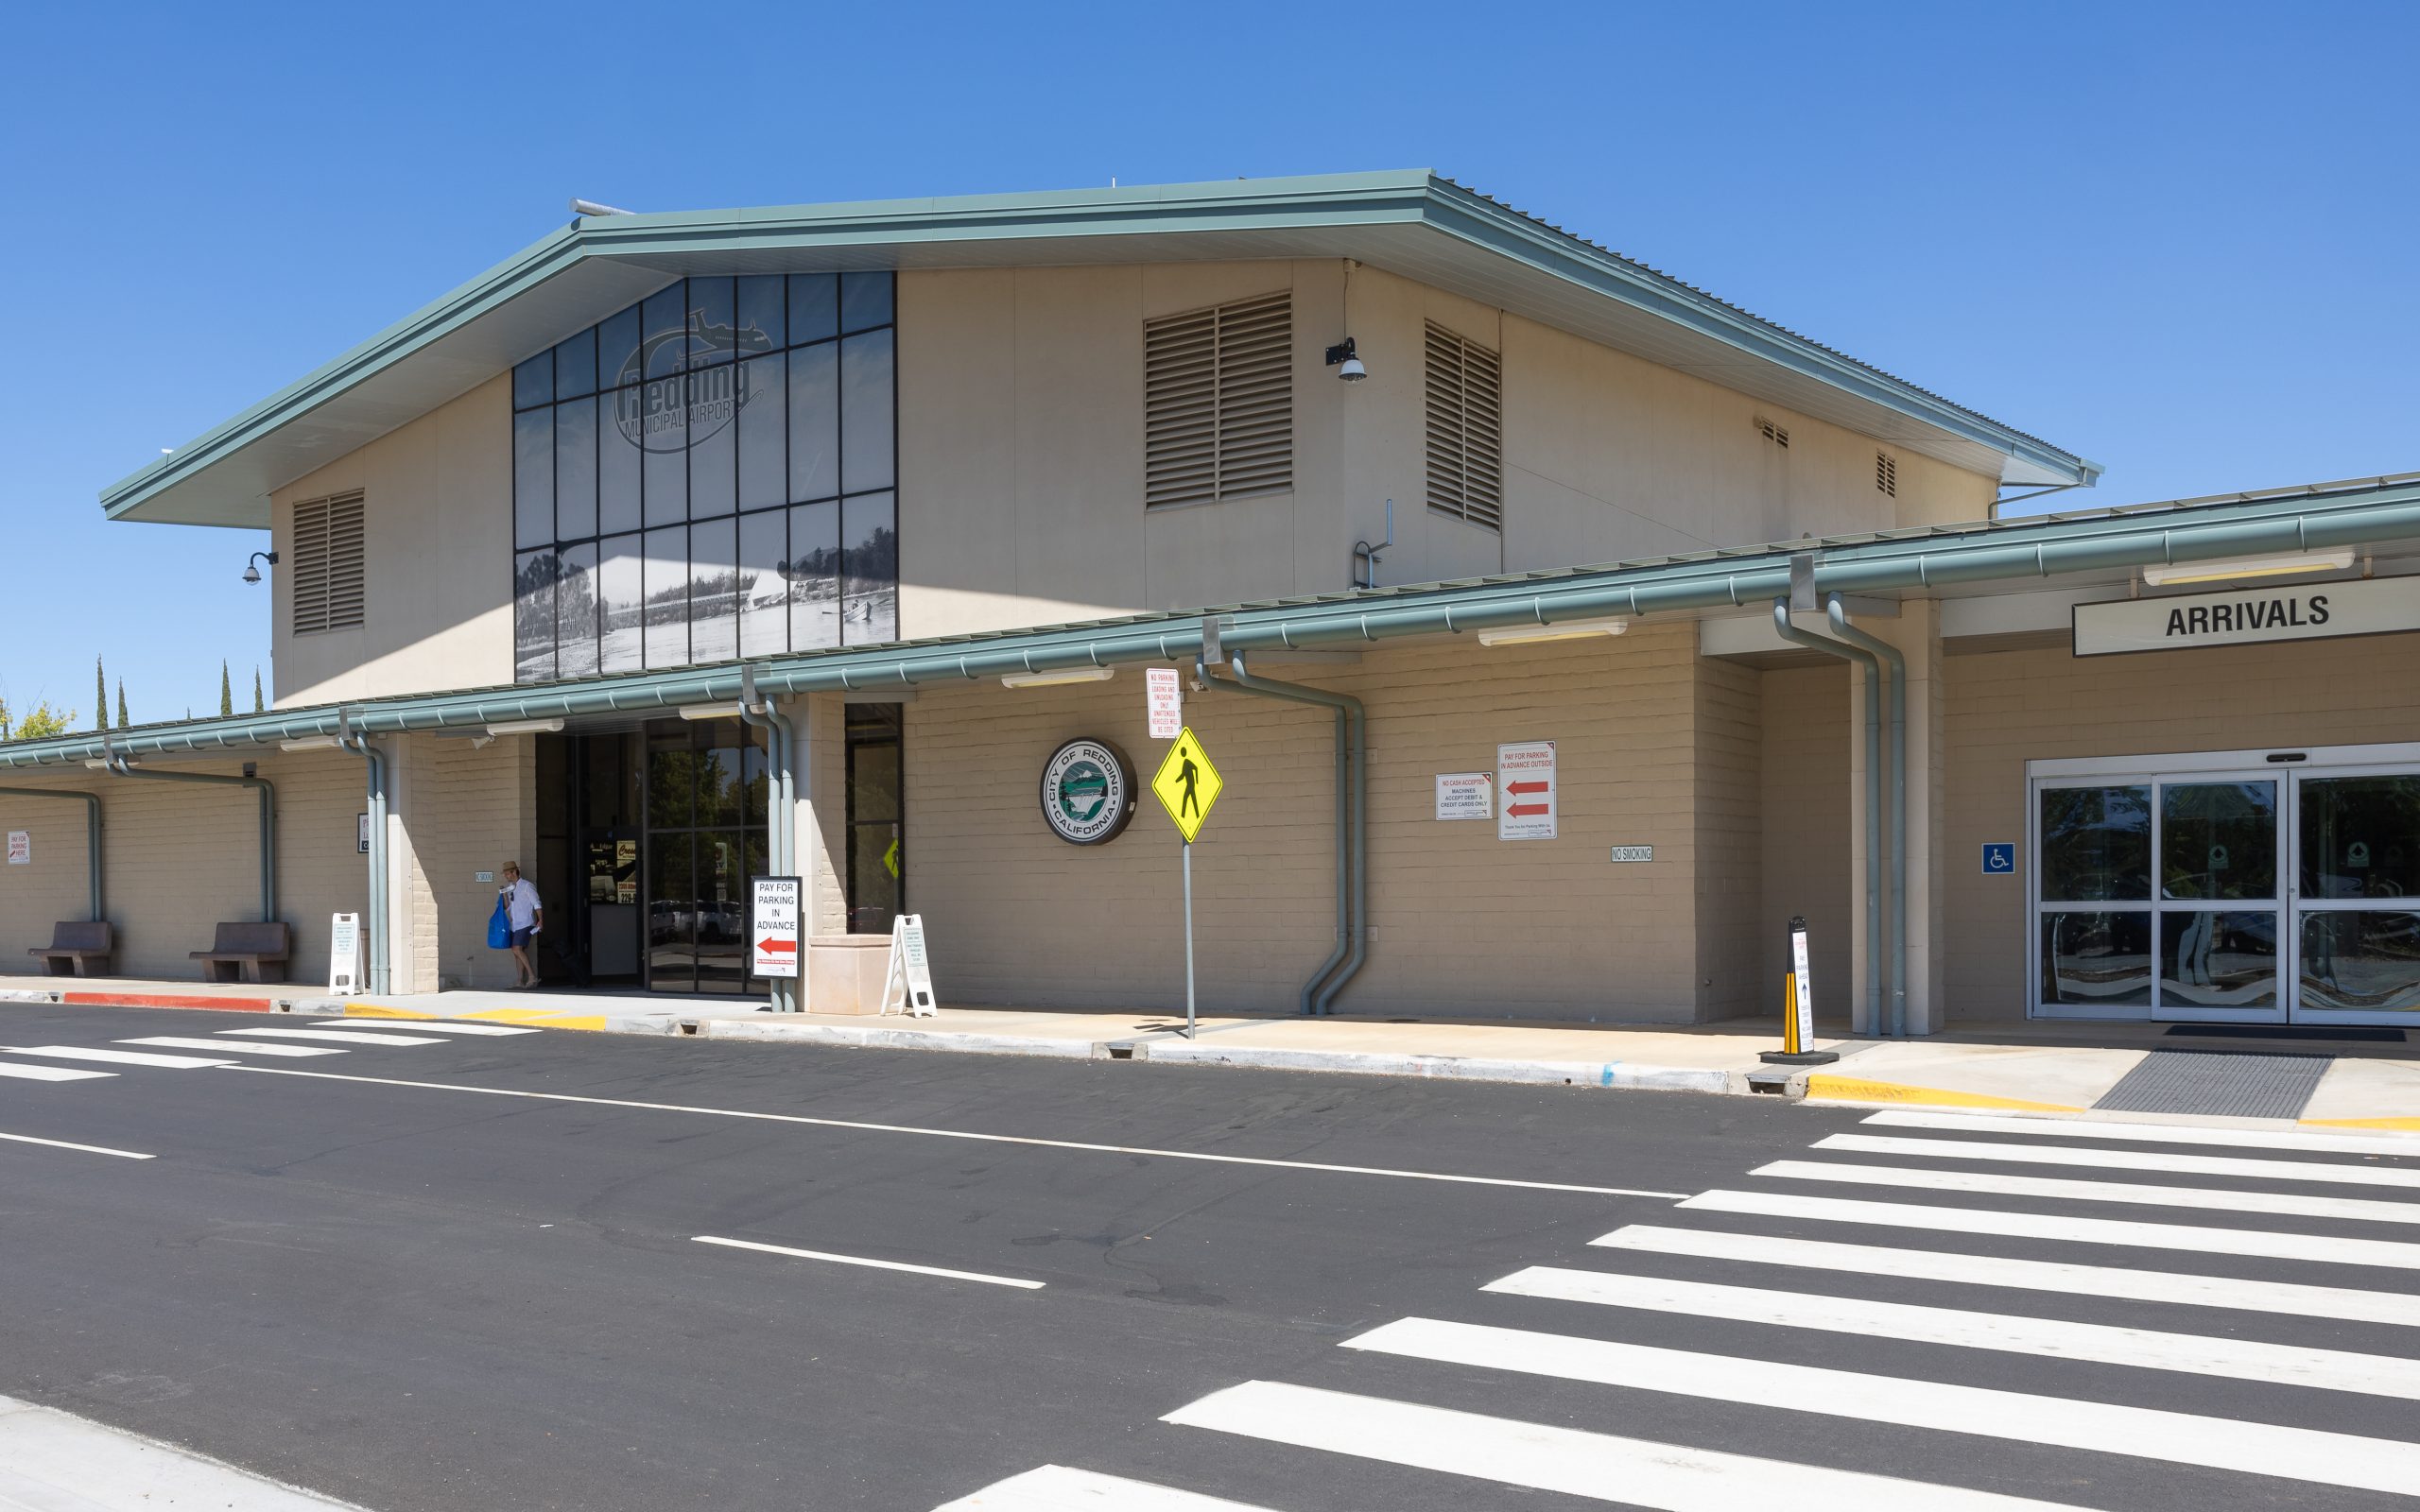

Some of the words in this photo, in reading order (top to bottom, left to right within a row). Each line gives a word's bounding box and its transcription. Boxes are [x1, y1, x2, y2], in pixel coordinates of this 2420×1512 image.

[625, 412, 684, 438] MUNICIPAL
[2166, 595, 2329, 636] ARRIVALS
[1507, 761, 1530, 769] ADVANCE
[1049, 768, 1060, 801] CITY
[1061, 751, 1076, 765] OF
[1082, 748, 1118, 796] REDDING
[1054, 807, 1115, 834] CALIFORNIA
[1613, 848, 1621, 860] NO
[1622, 848, 1651, 860] SMOKING
[759, 883, 774, 892] PAY
[776, 883, 793, 892] FOR
[758, 896, 794, 904] PARKING
[771, 908, 780, 917] IN
[756, 920, 795, 930] ADVANCE
